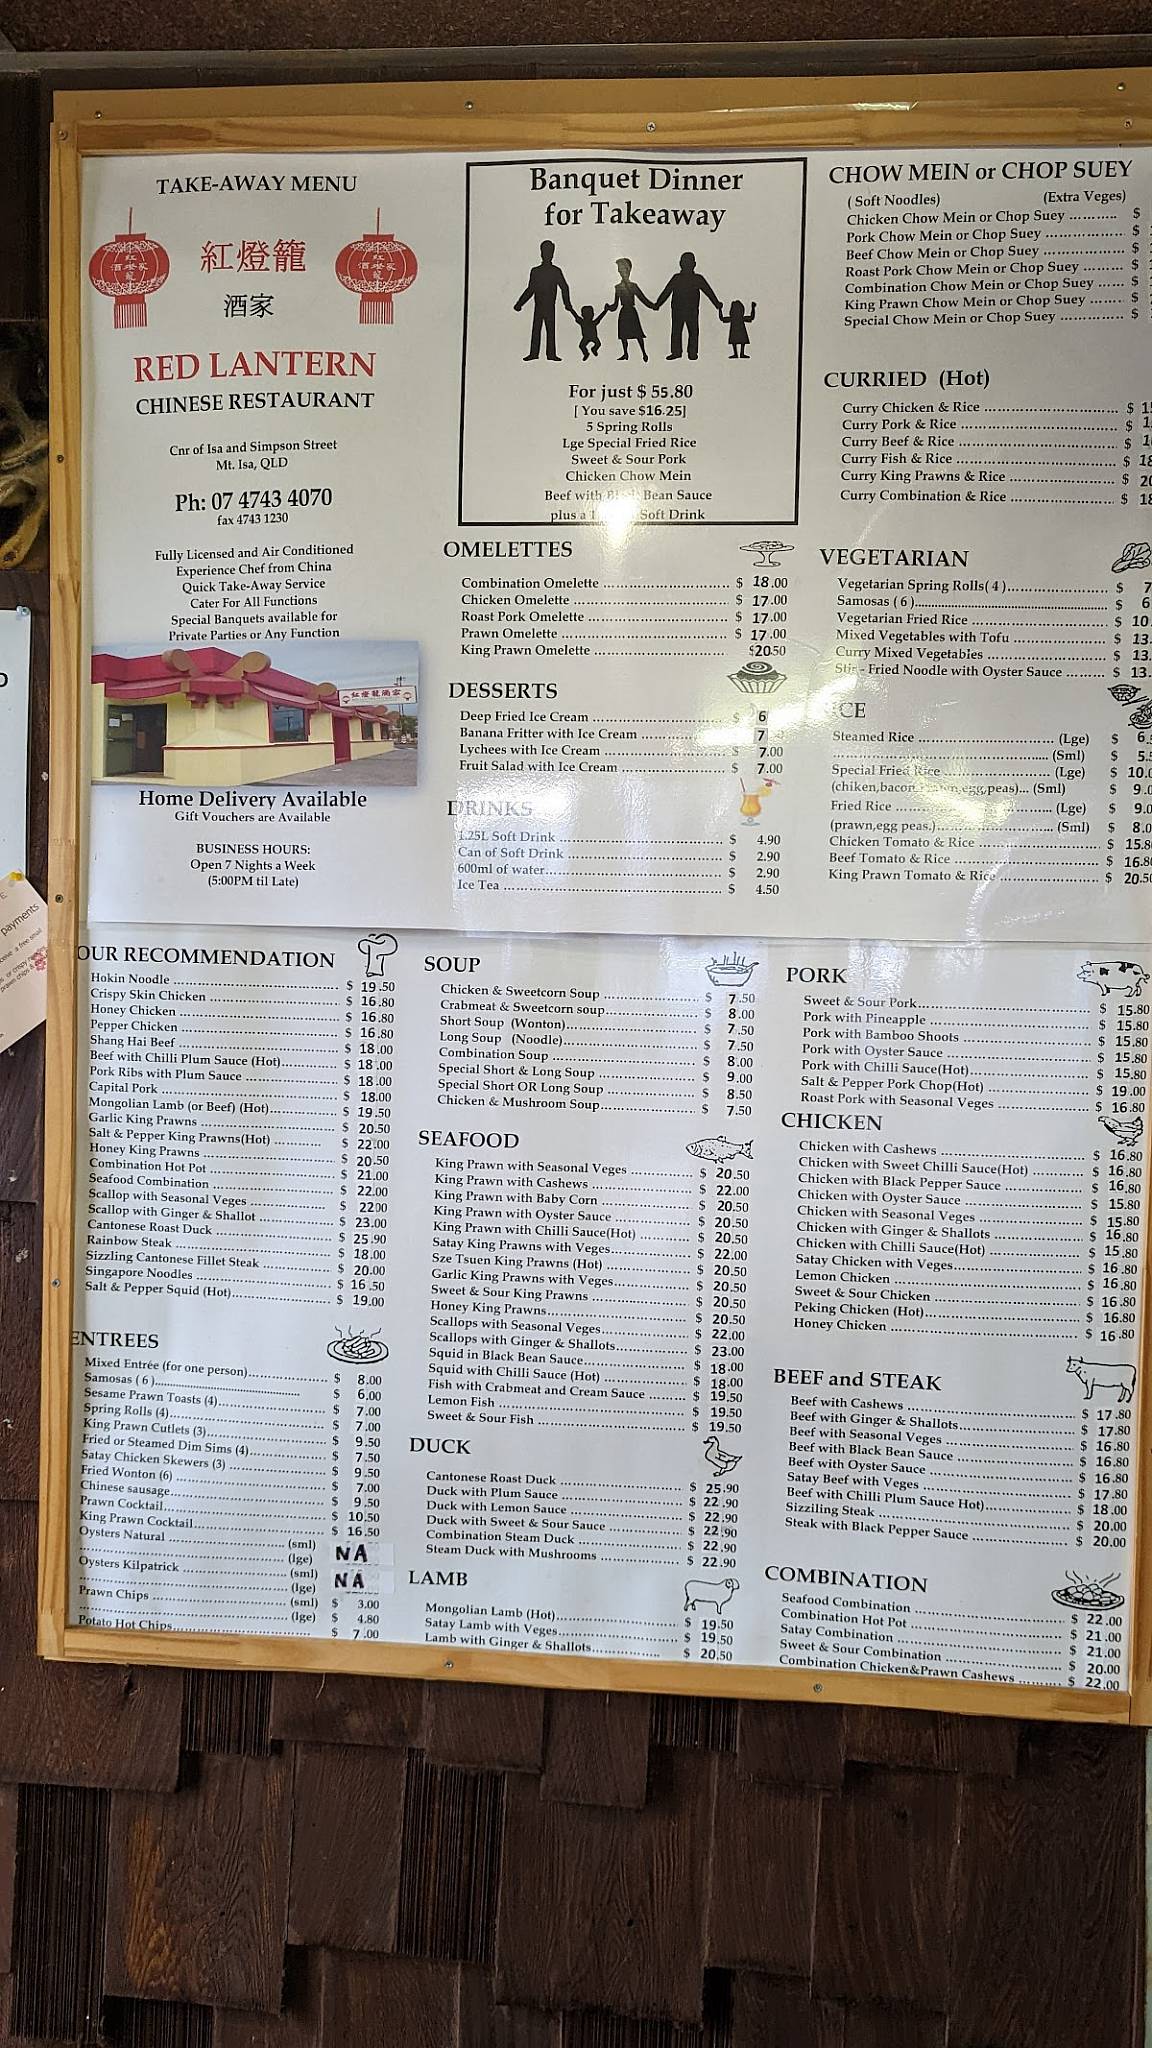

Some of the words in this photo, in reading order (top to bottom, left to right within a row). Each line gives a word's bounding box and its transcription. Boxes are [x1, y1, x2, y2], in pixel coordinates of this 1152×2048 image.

[828, 164, 903, 184] CHOW
[907, 162, 969, 181] MEIN
[975, 167, 996, 179] or
[1001, 161, 1067, 179] CHOP
[1073, 159, 1132, 178] SUEY
[155, 174, 285, 194] TAKE-AWAY
[290, 175, 357, 191] MENU
[529, 167, 640, 196] Banquet
[647, 167, 743, 190] Dinner
[1043, 191, 1079, 205] (Extra
[1082, 189, 1126, 205] Veges)
[543, 201, 583, 226] for
[590, 200, 726, 232] Takeaway
[200, 237, 306, 273] 紅燈籠
[846, 248, 874, 260] Beef
[876, 247, 913, 259] Chow
[917, 247, 950, 258] Mein
[953, 249, 967, 257] or
[969, 245, 1004, 259] Chop
[1007, 245, 1039, 258] Suey
[223, 292, 274, 318] 酒家
[132, 353, 199, 382] RED
[208, 350, 376, 377] LANTERN
[823, 371, 926, 389] CURRIED
[939, 368, 989, 390] (Hot)
[568, 384, 596, 398] For
[600, 384, 633, 402] just
[637, 383, 647, 400] $
[651, 384, 693, 399] 55.80
[135, 393, 223, 415] CHINESE
[228, 391, 374, 409] RESTAURANT
[585, 421, 593, 431] 5
[596, 421, 638, 434] Spring
[640, 421, 672, 431] Rolls
[169, 445, 190, 456] Cnr
[192, 443, 204, 454] of
[207, 443, 223, 454] Isa
[225, 441, 246, 453] and
[249, 440, 300, 454] Simpson
[303, 439, 337, 450] Street
[216, 459, 234, 470] Mt.
[238, 458, 257, 470] Isa,
[259, 456, 288, 470] QLD
[841, 452, 877, 466] Curry
[880, 452, 906, 463] Fish
[910, 452, 922, 463] &
[924, 452, 952, 463] Rice
[565, 470, 615, 481] Chicken
[619, 470, 655, 481] Chow
[659, 469, 691, 480] Mein
[175, 492, 205, 511] Ph:
[211, 491, 233, 510] 07
[238, 489, 281, 508] 4743
[287, 487, 332, 506] 4070
[216, 514, 233, 525] fax
[236, 513, 261, 524] 4743
[263, 511, 288, 523] 1230
[154, 549, 183, 563] Fully
[186, 547, 234, 559] Licensed
[237, 546, 258, 557] and
[261, 546, 279, 557] Air
[282, 543, 353, 556] Conditioned
[443, 540, 572, 557] OMELETTES
[818, 548, 969, 567] VEGETARIAN
[182, 581, 216, 594] Quick
[218, 580, 282, 592] Take-Away
[284, 577, 325, 589] Service
[461, 577, 540, 588] Combination
[543, 577, 599, 588] Omelette
[735, 576, 743, 589] $
[752, 575, 787, 588] 18.00
[836, 611, 902, 626] Vegetarian
[906, 613, 937, 624] Fried
[941, 613, 967, 625] Rice
[448, 682, 557, 699] DESSERTS
[459, 759, 488, 770] Fruit
[490, 760, 524, 771] Salad
[527, 760, 554, 771] with
[558, 761, 575, 771] Ice
[578, 761, 617, 772] Cream
[138, 790, 193, 806] Home
[199, 790, 276, 810] Delivery
[282, 790, 367, 807] Available
[195, 843, 258, 854] BUSINESS
[262, 844, 310, 854] HOURS:
[829, 835, 879, 846] Chicken
[882, 836, 929, 847] Tomato
[933, 836, 944, 847] &
[947, 836, 974, 847] Rice
[456, 878, 474, 889] Ice
[477, 879, 499, 890] Tea
[727, 883, 735, 894] $
[755, 883, 779, 894] 4.50
[0, 903, 39, 937] payments
[77, 945, 118, 961] OUR
[123, 946, 335, 968] RECOMMENDATION
[424, 955, 480, 972] SOUP
[785, 966, 847, 983] PORK
[90, 987, 126, 1001] Crispy
[129, 989, 155, 999] Skin
[158, 990, 205, 1001] Chicken
[345, 995, 352, 1006] $
[361, 995, 394, 1007] 16.80
[439, 1030, 468, 1045] Long
[471, 1031, 501, 1045] Soup
[511, 1033, 562, 1047] (Noodle)
[703, 1039, 710, 1050] $
[727, 1039, 753, 1051] 7.50
[802, 1043, 830, 1054] Pork
[834, 1044, 860, 1055] with
[864, 1045, 904, 1058] Oyster
[907, 1046, 942, 1057] Sauce
[781, 1112, 882, 1130] CHICKEN
[418, 1129, 519, 1148] SEAFOOD
[434, 1173, 463, 1187] King
[466, 1174, 503, 1186] Prawn
[506, 1176, 533, 1187] with
[536, 1177, 588, 1188] Cashews
[699, 1183, 706, 1194] $
[716, 1184, 749, 1196] 22.00
[84, 1265, 143, 1279] Singapore
[146, 1267, 192, 1279] Noodles
[337, 1278, 343, 1289] $
[350, 1278, 384, 1291] 16.50
[795, 1269, 836, 1281] Lemon
[839, 1271, 890, 1283] Chicken
[71, 1330, 158, 1348] ENTREES
[773, 1368, 824, 1385] BEEF
[828, 1370, 863, 1386] and
[869, 1372, 941, 1391] STEAK
[83, 1402, 121, 1417] Spring
[123, 1404, 152, 1416] Rolls
[155, 1407, 168, 1420] (4)
[332, 1419, 339, 1430] $
[355, 1420, 380, 1432] 7.00
[409, 1436, 471, 1454] DUCK
[426, 1485, 457, 1495] Duck
[460, 1486, 486, 1496] with
[490, 1487, 520, 1497] Plum
[524, 1488, 558, 1499] Sauce
[841, 1505, 874, 1517] Steak
[1076, 1519, 1083, 1531] $
[1093, 1519, 1126, 1531] 20.00
[408, 1570, 467, 1586] LAMB
[764, 1565, 927, 1592] COMBINATION
